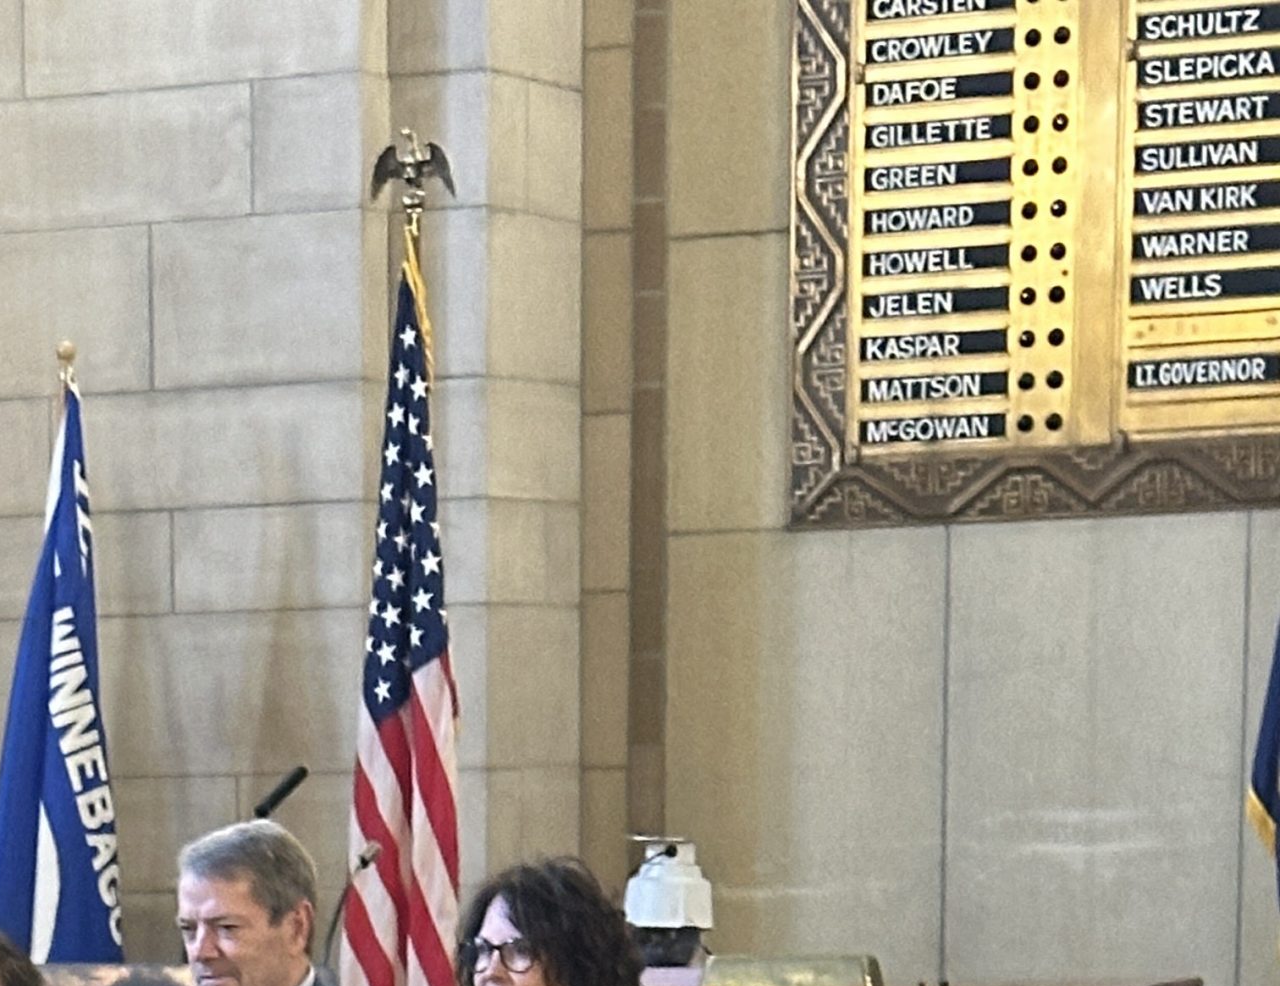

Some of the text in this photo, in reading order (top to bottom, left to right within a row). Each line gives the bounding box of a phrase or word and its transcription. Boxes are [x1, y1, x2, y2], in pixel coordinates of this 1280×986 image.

[1144, 9, 1261, 39] SCHULTZ
[871, 31, 993, 62] CROWLEY
[1144, 51, 1275, 84] SLEPICKA
[872, 78, 957, 105] DAFOE
[1144, 95, 1269, 127] STEWART
[871, 118, 992, 147] GILLETTE
[1141, 141, 1258, 171] SULLIVAN
[870, 164, 957, 190] GREEN
[1142, 185, 1257, 213] VAN KIRK
[871, 206, 974, 233] HOWARD
[1140, 231, 1249, 258] WARNER
[869, 249, 974, 275] HOWELL
[1139, 274, 1222, 300] WELLS
[869, 292, 953, 317] JELEN
[866, 335, 960, 360] KASPAR
[867, 375, 981, 402] MATTSON
